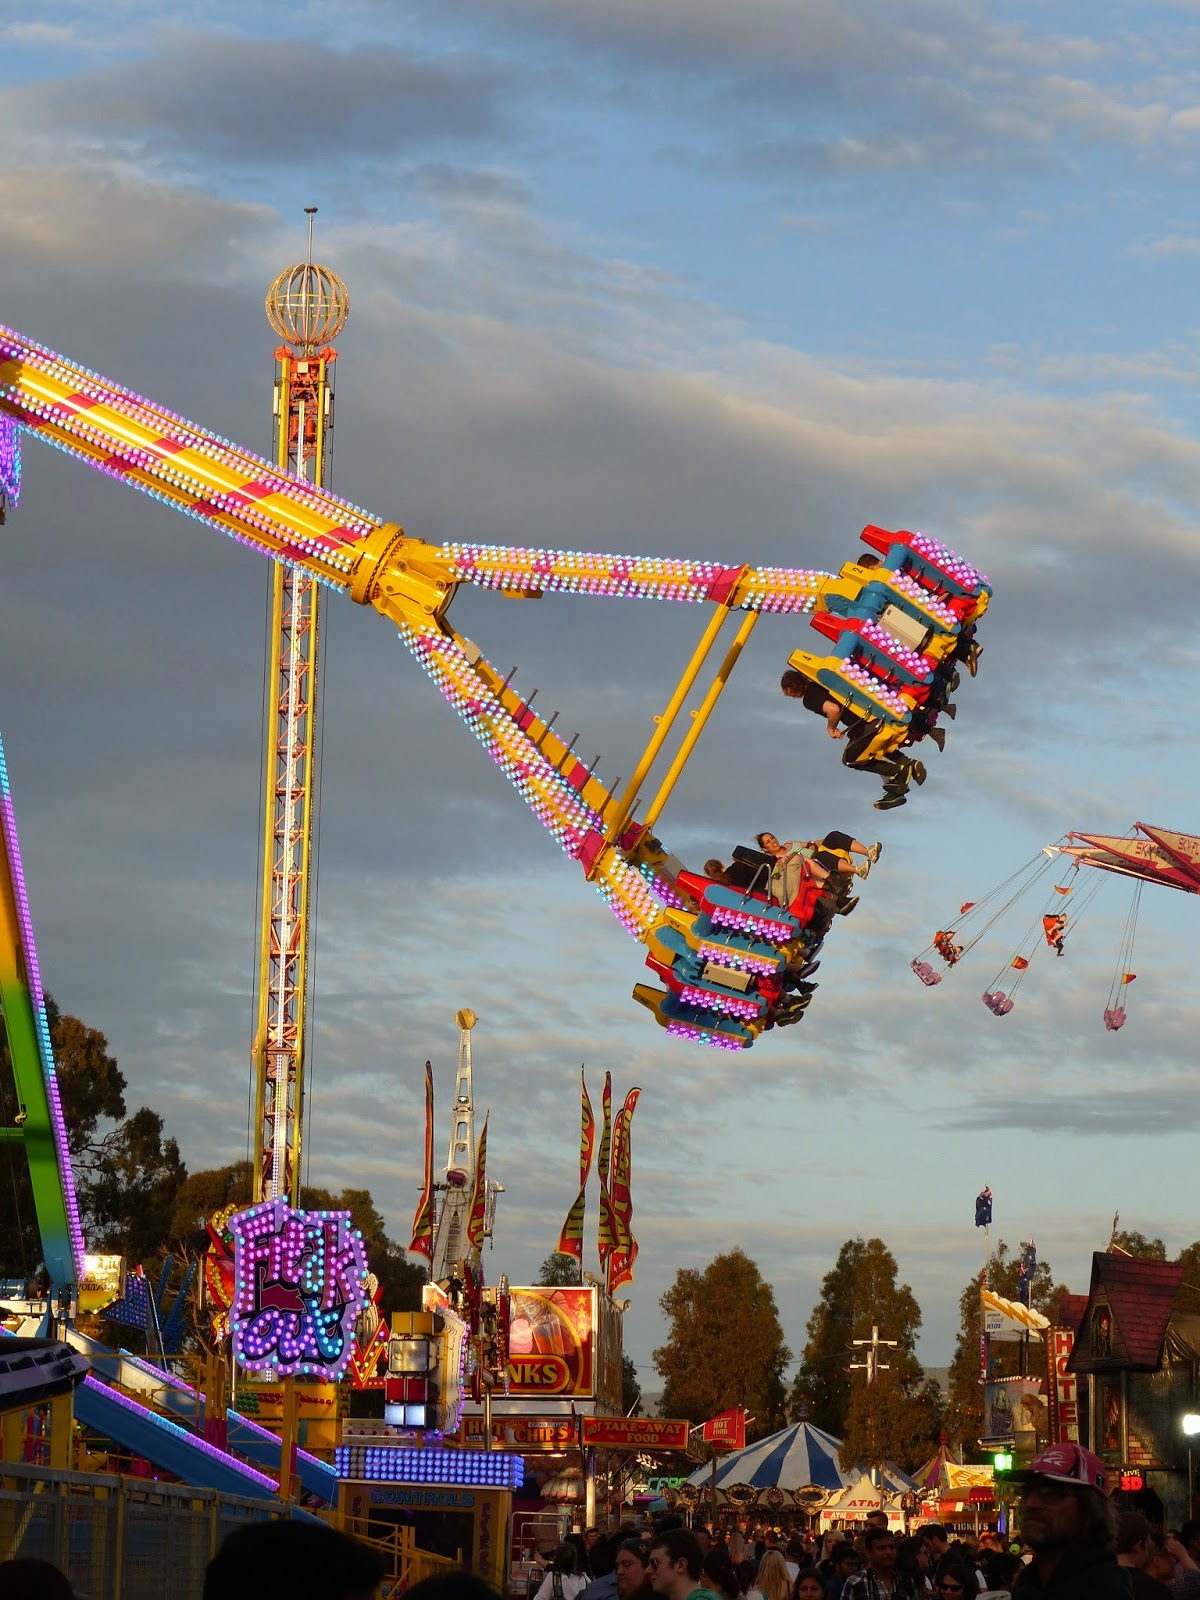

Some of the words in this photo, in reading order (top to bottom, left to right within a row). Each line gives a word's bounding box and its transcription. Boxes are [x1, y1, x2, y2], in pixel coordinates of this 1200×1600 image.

[497, 1363, 558, 1384] NKS
[468, 1420, 505, 1436] HOT
[587, 1422, 602, 1437] HOT
[604, 1421, 683, 1434] TAKE-AWAY
[713, 1420, 729, 1429] HOT
[514, 1425, 569, 1442] CHIPS
[627, 1432, 660, 1443] FOOD
[1123, 1468, 1140, 1477] LIVE
[1121, 1476, 1143, 1491] 3D
[370, 1489, 475, 1508] CONTROLS
[847, 1499, 881, 1508] ATM
[830, 1512, 847, 1520] ATM
[952, 1522, 989, 1531] TICKETS
